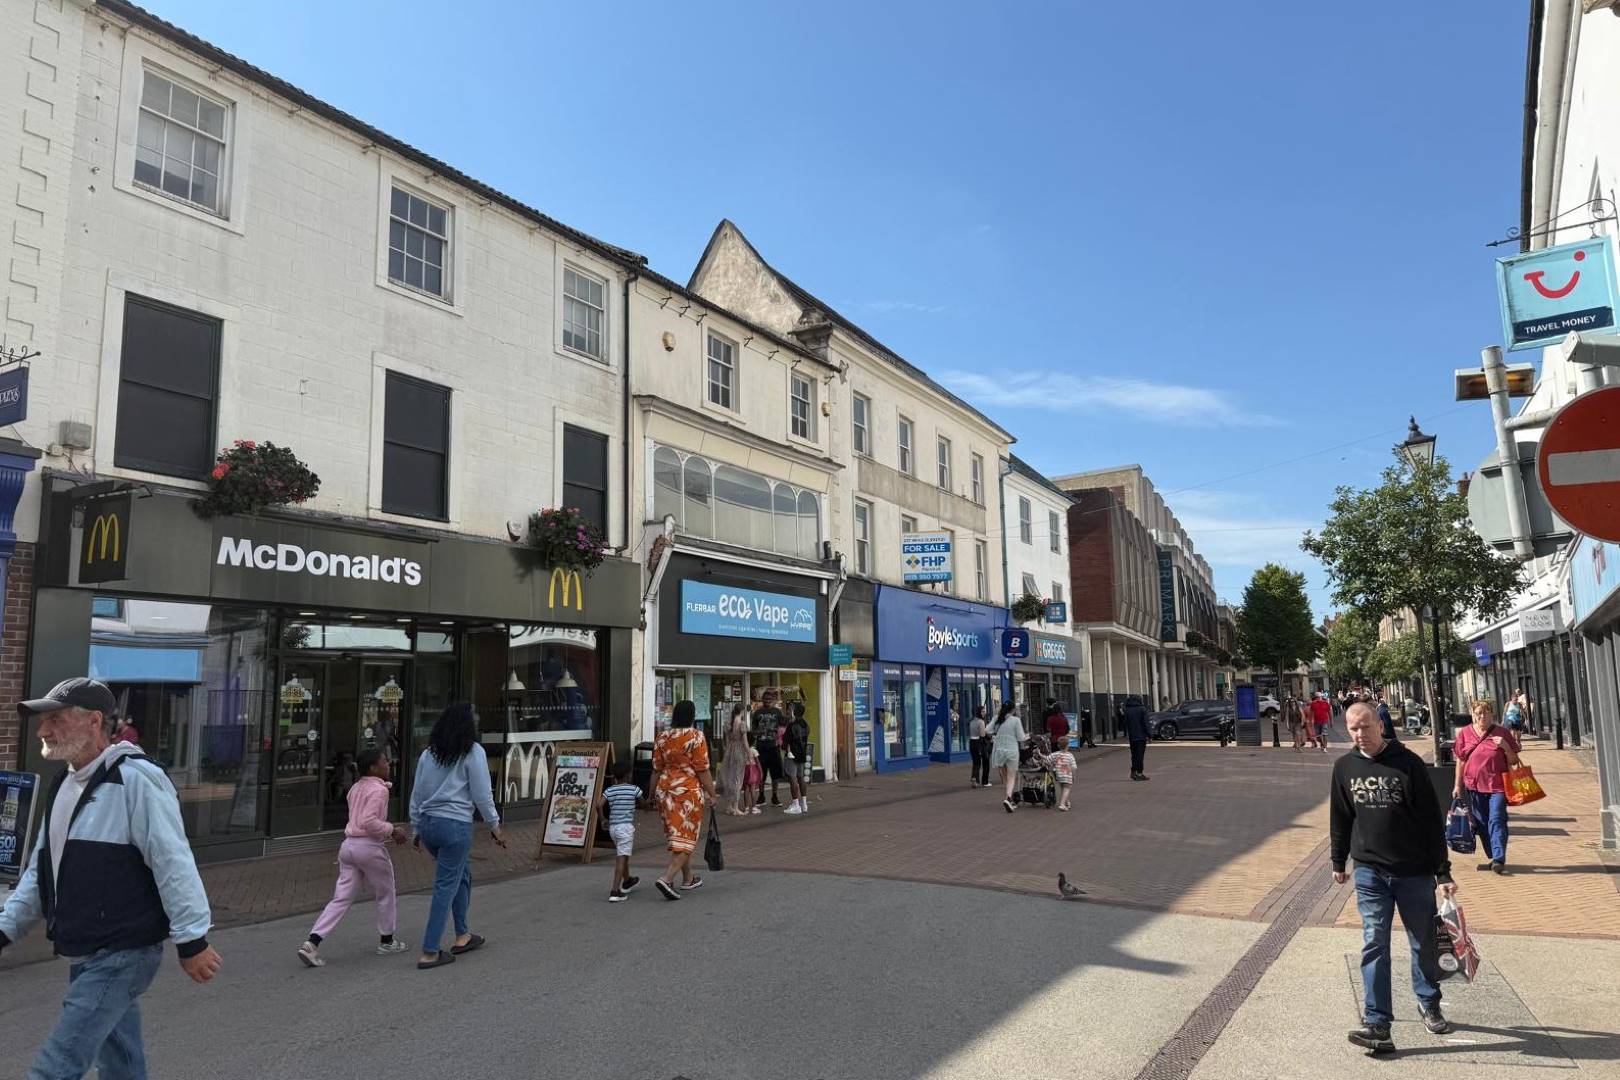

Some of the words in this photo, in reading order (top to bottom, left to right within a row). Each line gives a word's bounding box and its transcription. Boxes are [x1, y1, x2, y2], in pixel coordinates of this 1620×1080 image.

[1524, 322, 1560, 334] TRAVEL
[1561, 315, 1596, 327] MONEY
[216, 536, 422, 586] McDonald's
[921, 556, 946, 567] FHP
[1160, 559, 1175, 637] PRIMARK
[754, 598, 789, 627] Vape
[928, 625, 979, 650] BoyleSports
[554, 784, 588, 796] ARCH
[1350, 776, 1389, 791] JACK
[1353, 790, 1402, 803] JONES
